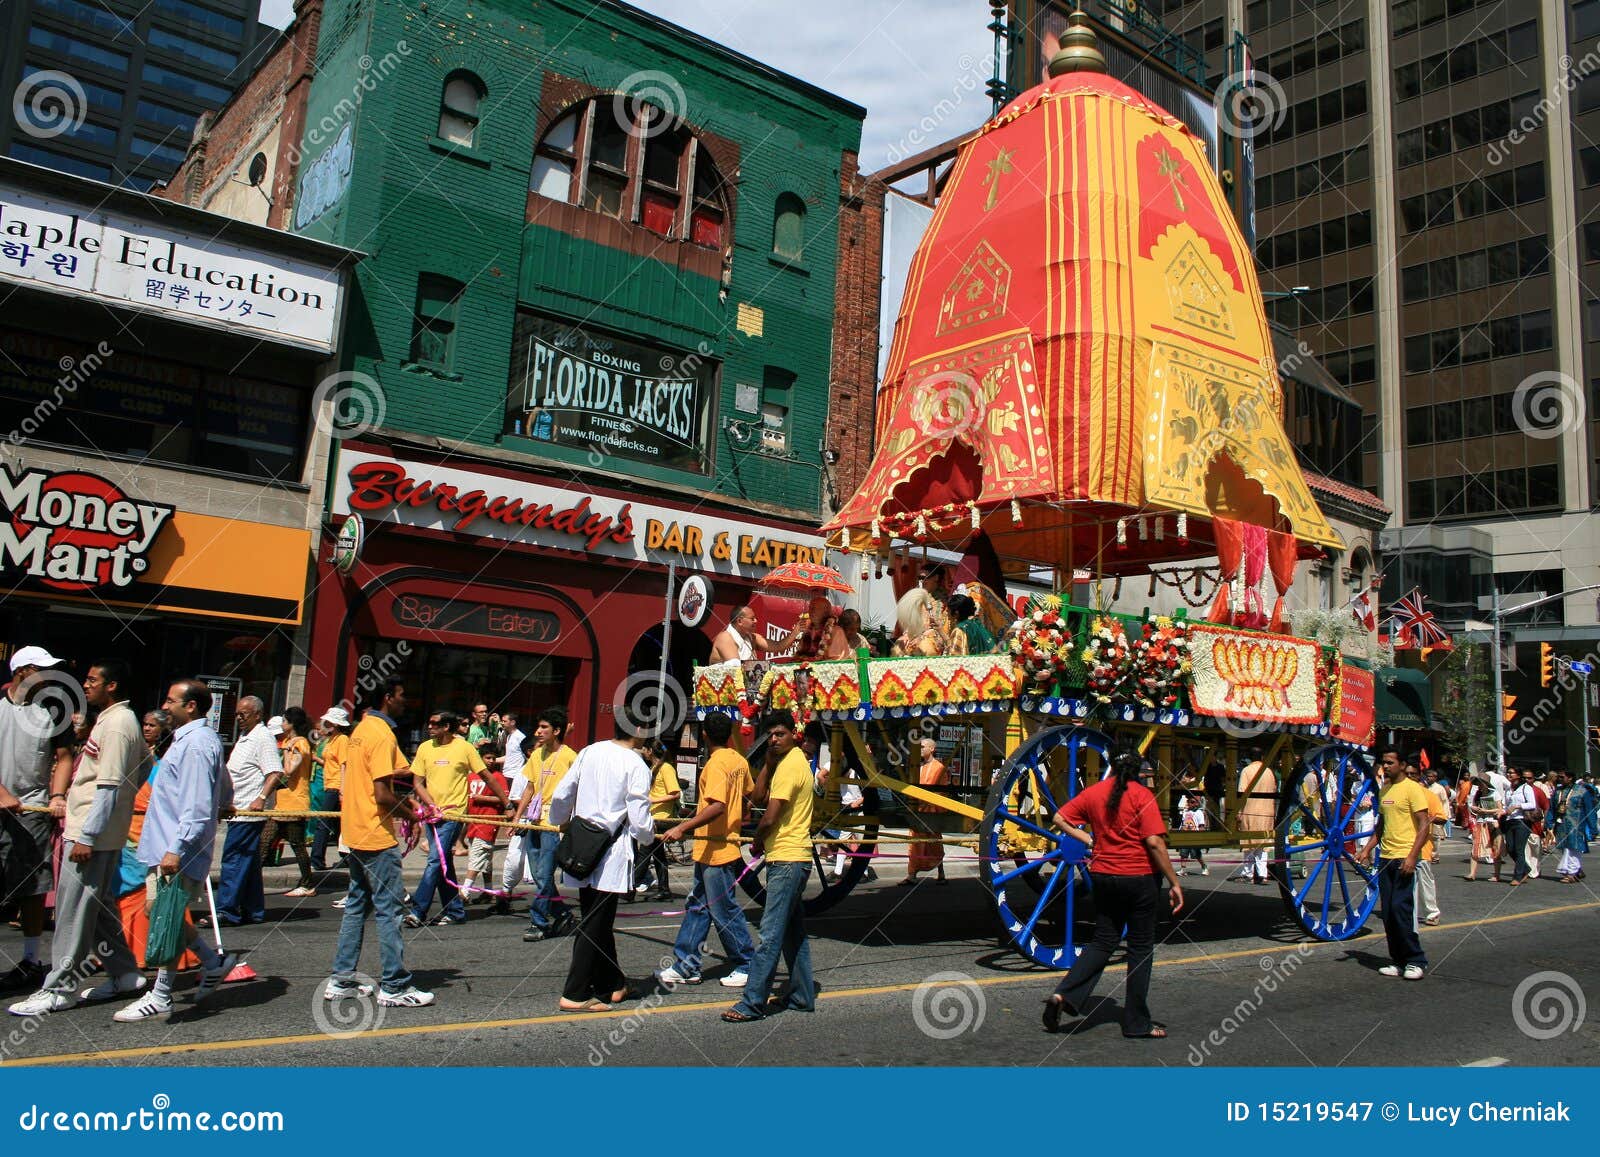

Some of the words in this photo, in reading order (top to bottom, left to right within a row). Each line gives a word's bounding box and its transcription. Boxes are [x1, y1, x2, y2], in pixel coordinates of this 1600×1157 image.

[0, 205, 101, 253] aple
[117, 234, 325, 310] Education
[146, 278, 276, 319] 留学センター
[592, 351, 641, 373] BOXING
[91, 377, 193, 405] CONVERSATION
[119, 397, 165, 416] CLUBS
[529, 342, 624, 416] FLORIDA
[629, 378, 693, 440] JACKS
[560, 425, 659, 455] www.floridajacks.ca
[591, 416, 632, 434] FITNESS
[0, 468, 171, 553] Money
[349, 461, 636, 551] Burgundy's
[645, 519, 704, 556] BAR
[713, 531, 732, 560] &
[738, 533, 825, 567] EATERY
[0, 522, 132, 587] Mart
[401, 597, 440, 624] Bar
[488, 607, 551, 641] Eatery
